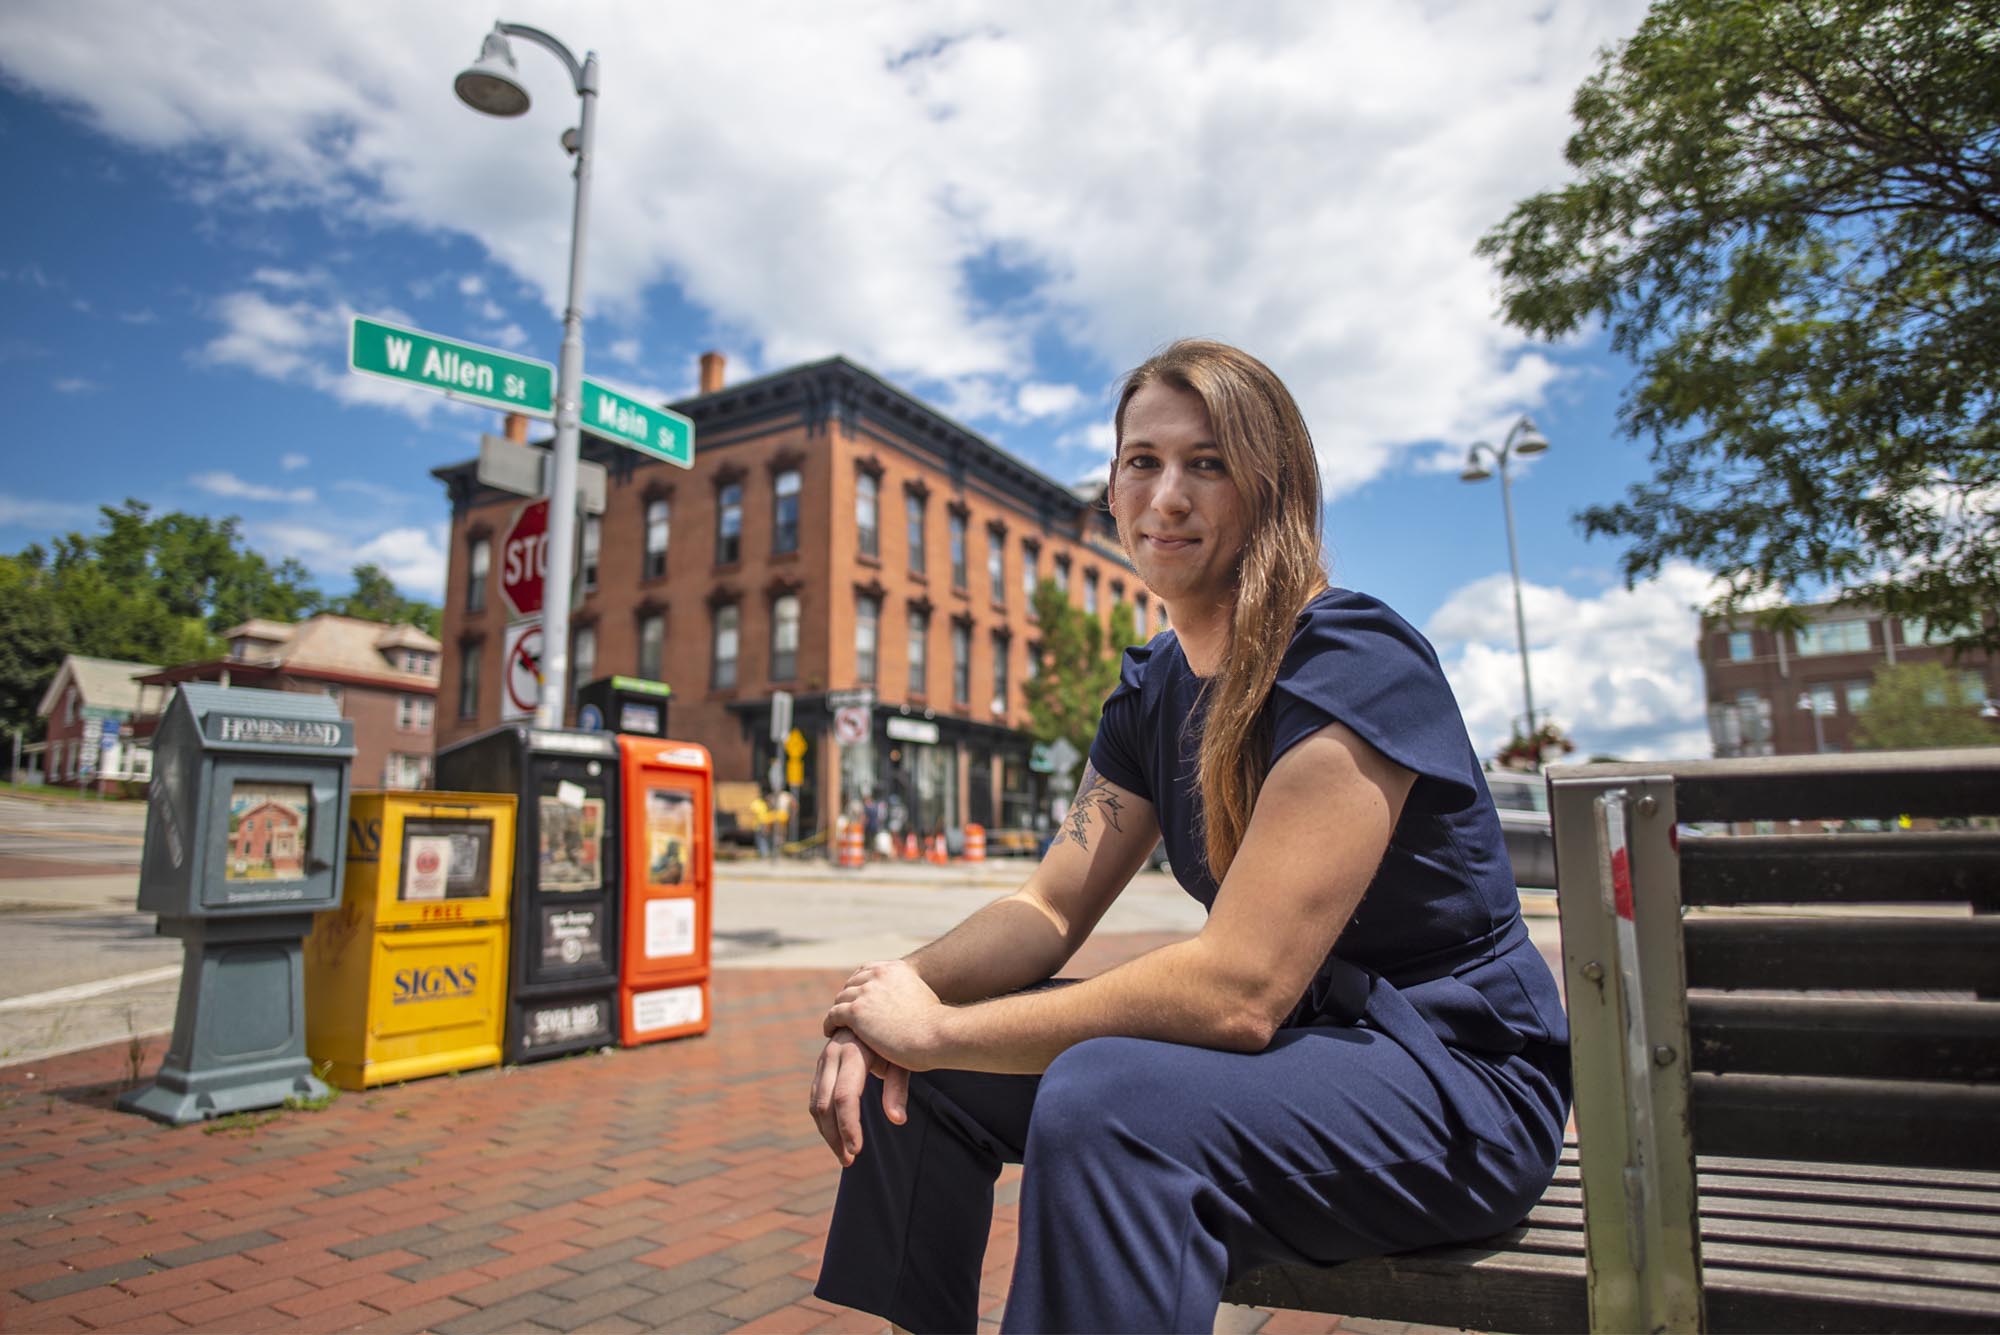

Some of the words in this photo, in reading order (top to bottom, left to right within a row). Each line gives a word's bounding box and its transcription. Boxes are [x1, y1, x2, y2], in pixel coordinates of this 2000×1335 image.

[385, 335, 412, 372] W
[422, 346, 494, 392] Allen
[503, 374, 527, 400] St
[598, 395, 649, 440] Main
[657, 426, 676, 452] St
[506, 533, 548, 586] STO
[421, 904, 464, 922] FREE
[395, 962, 478, 996] SIGNS
